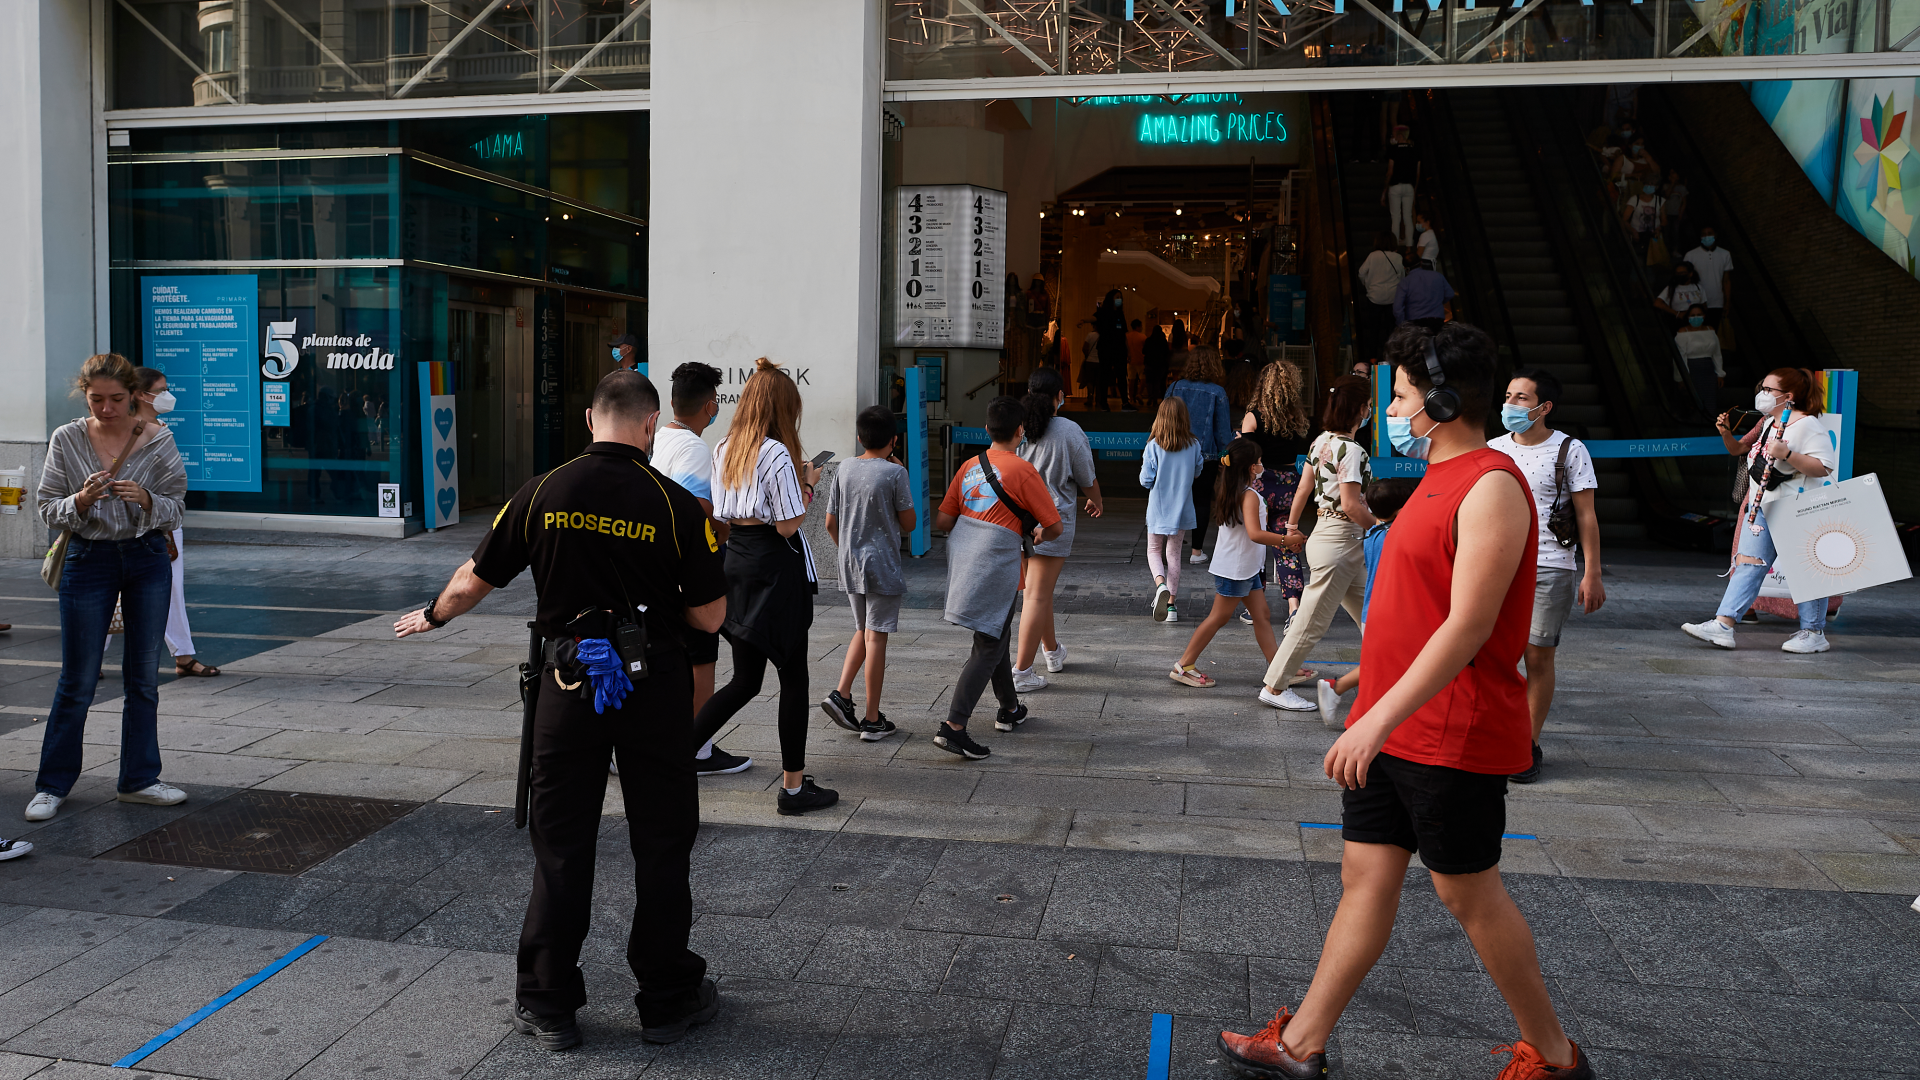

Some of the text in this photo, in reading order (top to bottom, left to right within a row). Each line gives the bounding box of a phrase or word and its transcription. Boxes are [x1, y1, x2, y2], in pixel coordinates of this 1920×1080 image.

[1140, 112, 1287, 143] AMAZING PRICES
[908, 194, 923, 212] 4
[974, 195, 983, 214] 4
[908, 215, 922, 234] 3
[974, 216, 983, 235] 3
[908, 237, 922, 255] 2
[974, 238, 983, 256] 2
[911, 258, 921, 276] 1
[975, 260, 982, 278] 1
[152, 284, 180, 294] CUÍDATE.
[906, 279, 922, 297] 0
[972, 280, 983, 299] 0
[152, 293, 190, 302] PROTÉGETE.
[262, 318, 299, 379] 5
[302, 334, 372, 349] plantas de
[327, 347, 394, 370] moda
[1088, 436, 1140, 445] PRIMARK
[1630, 443, 1687, 453] PRIMARK
[544, 511, 656, 542] PROSEGUR
